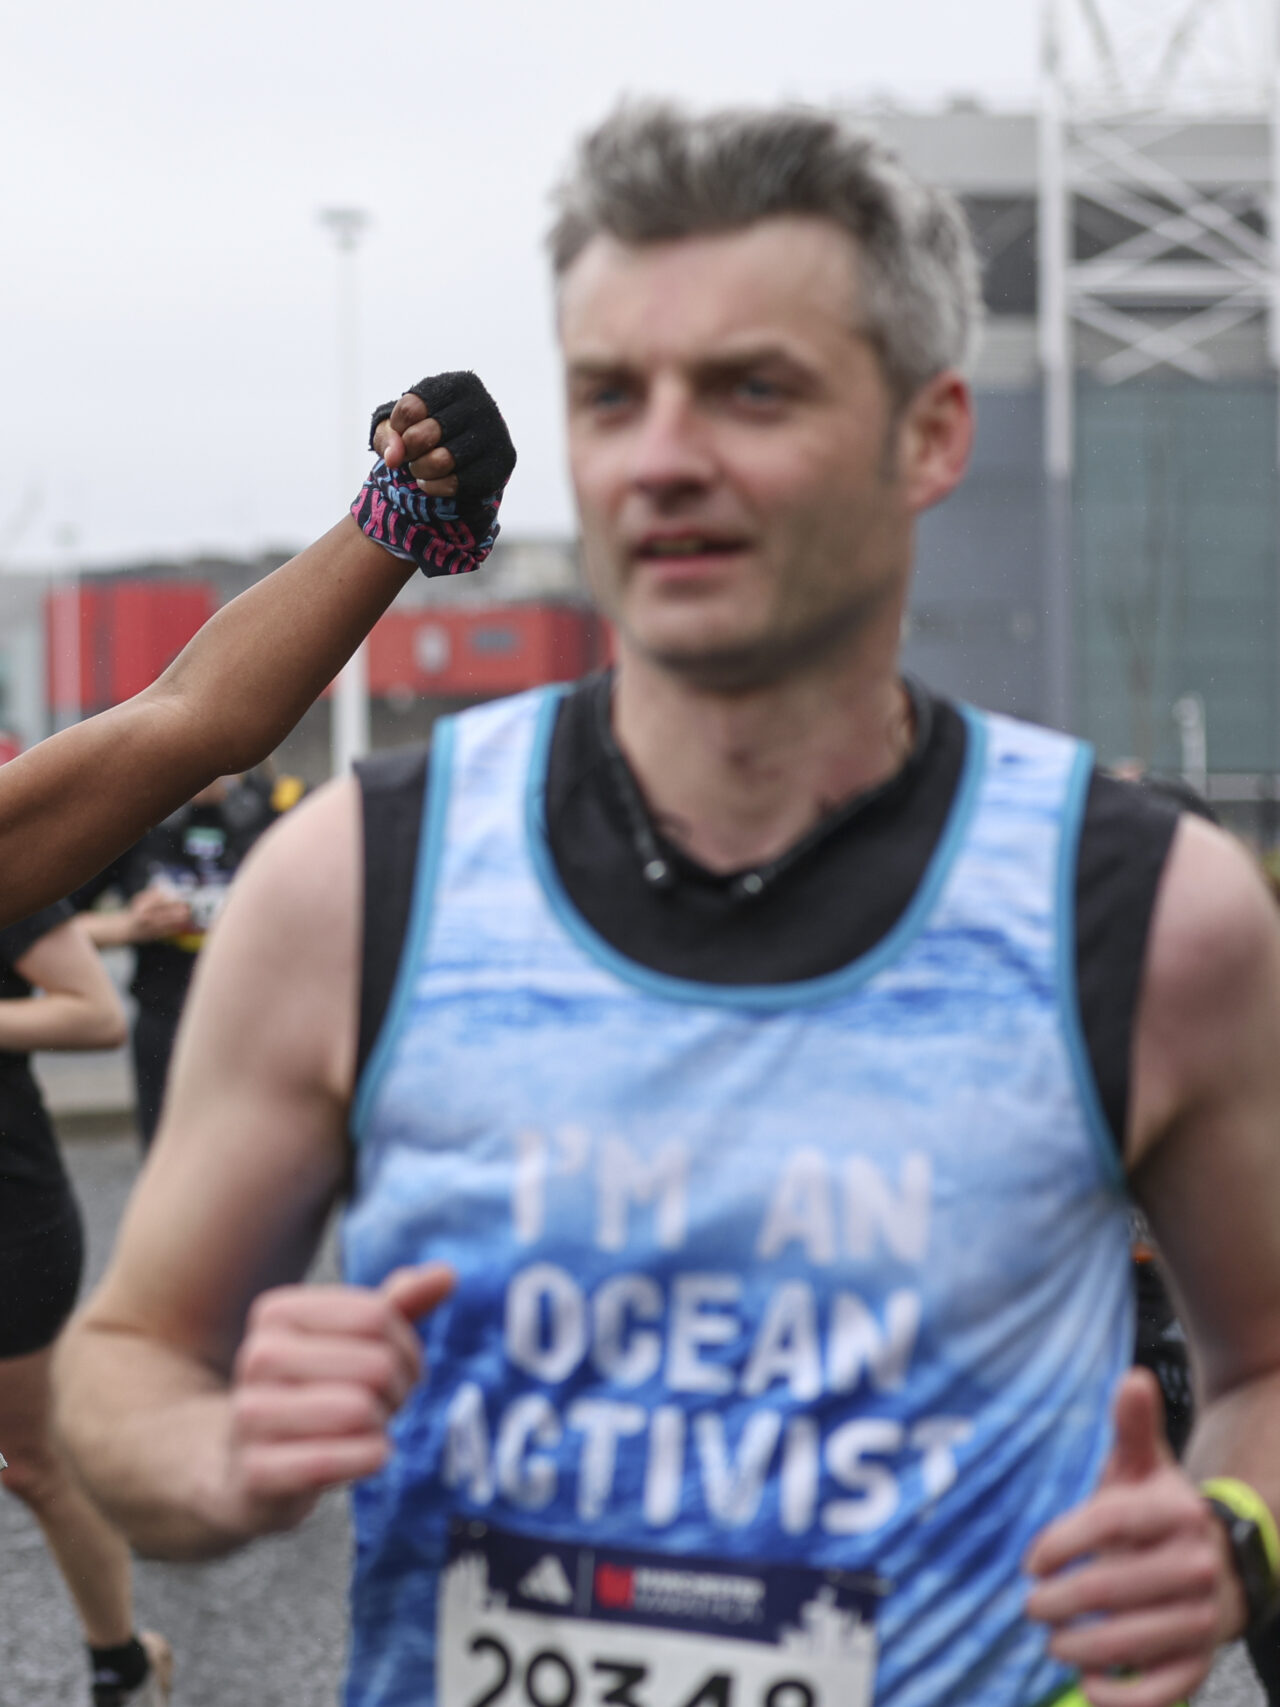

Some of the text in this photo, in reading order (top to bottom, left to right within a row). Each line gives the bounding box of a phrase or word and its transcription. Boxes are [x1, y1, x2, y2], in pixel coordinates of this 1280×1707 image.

[508, 1121, 932, 1265] I'M AN
[504, 1263, 924, 1404] OCEAN
[439, 1381, 977, 1536] ACTIVIST
[464, 1633, 819, 1707] 293
